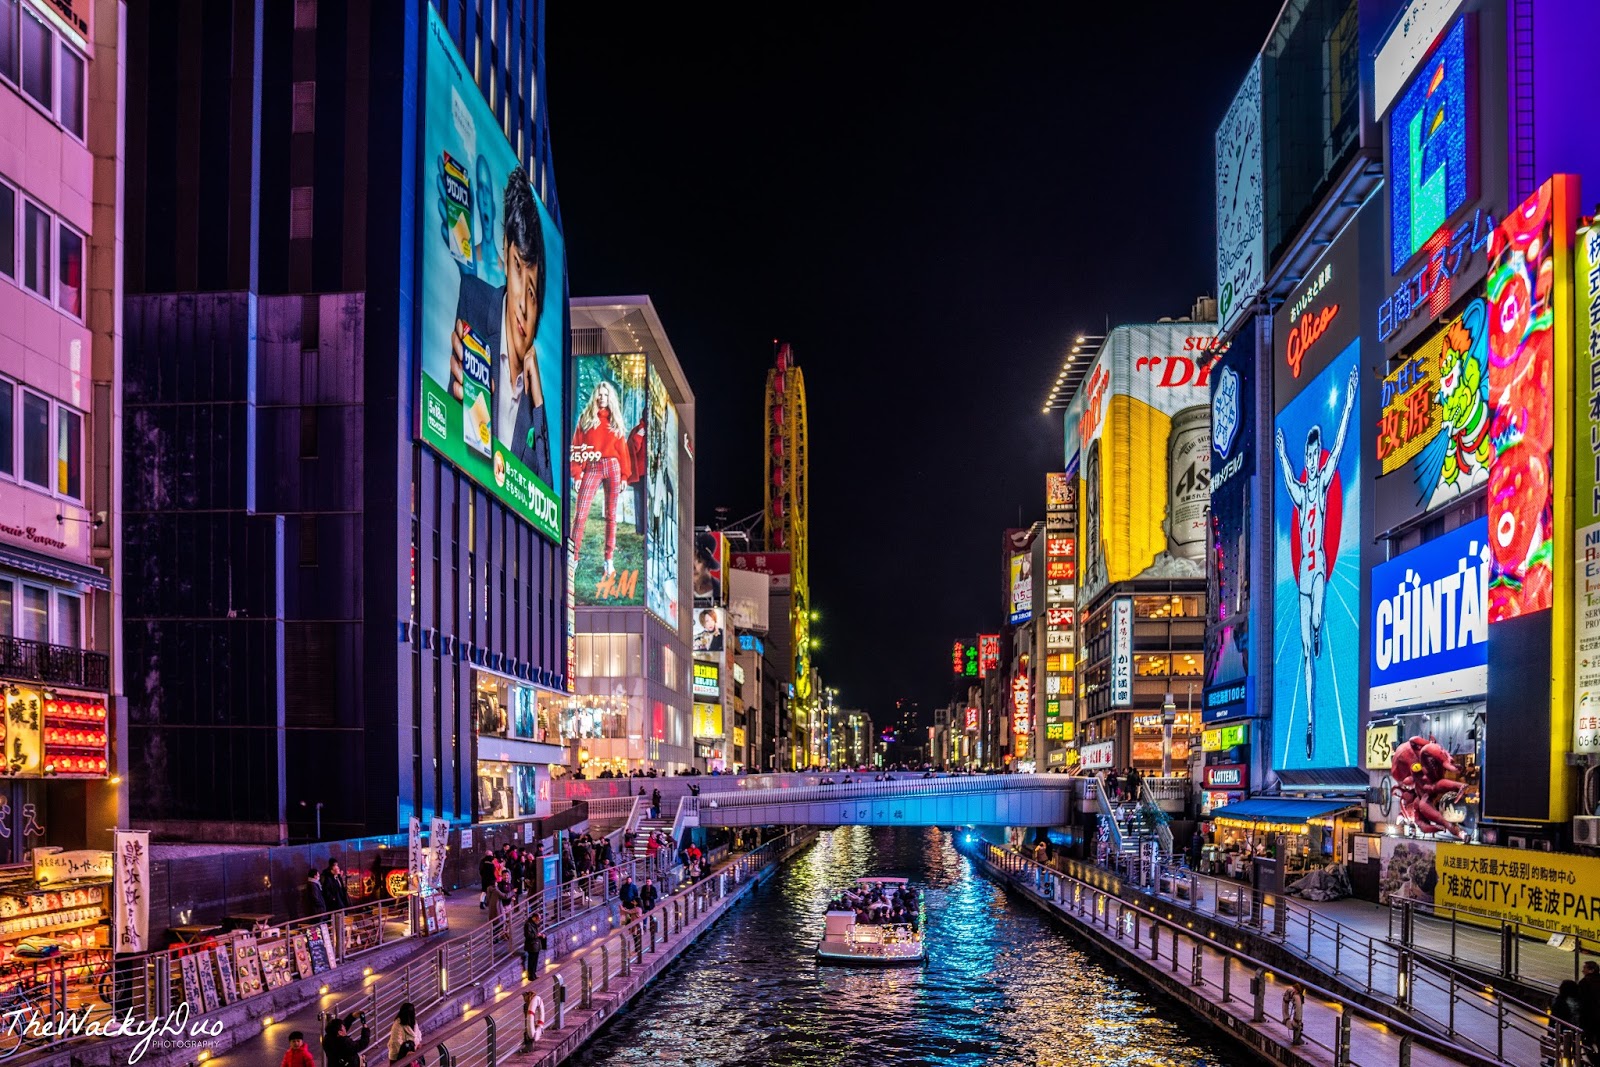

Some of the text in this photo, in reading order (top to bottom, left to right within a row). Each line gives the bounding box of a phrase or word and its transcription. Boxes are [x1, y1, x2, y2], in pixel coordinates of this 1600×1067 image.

[1289, 263, 1332, 324] おいしさと健康
[1377, 207, 1497, 343] 日商エステム
[1287, 304, 1339, 379] Glico
[464, 349, 490, 388] サロンパス
[1381, 356, 1425, 408] かぜに
[1375, 380, 1432, 463] 改源
[528, 479, 560, 533] サロンパス
[1306, 502, 1318, 573] グリコ
[595, 569, 639, 600] H&M
[1012, 674, 1029, 735] 大阪王将
[1371, 732, 1391, 763] くくる
[1213, 768, 1238, 782] LOTTERIA
[1442, 855, 1576, 885] 从这里到大阪最大级别的购物中心
[1561, 924, 1572, 934] and
